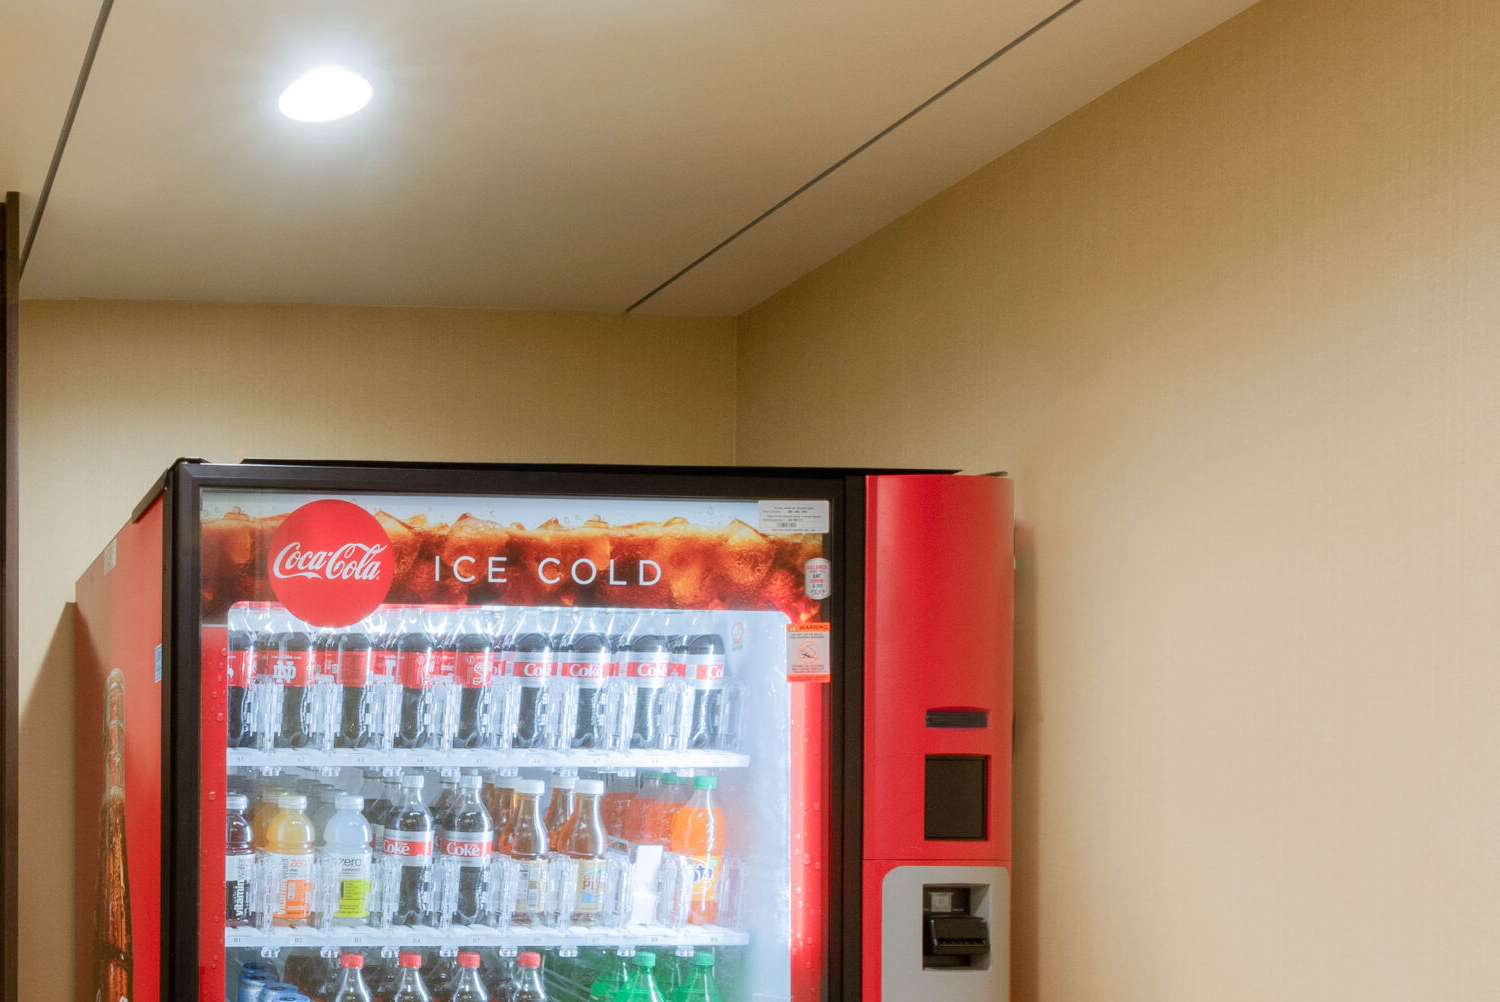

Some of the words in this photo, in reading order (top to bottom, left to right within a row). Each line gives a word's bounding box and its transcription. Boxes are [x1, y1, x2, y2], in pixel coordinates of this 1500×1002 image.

[273, 542, 388, 581] Coca-Cola
[434, 556, 507, 583] ICE
[537, 558, 663, 586] COLD
[446, 842, 480, 856] Coke
[339, 858, 362, 867] zero
